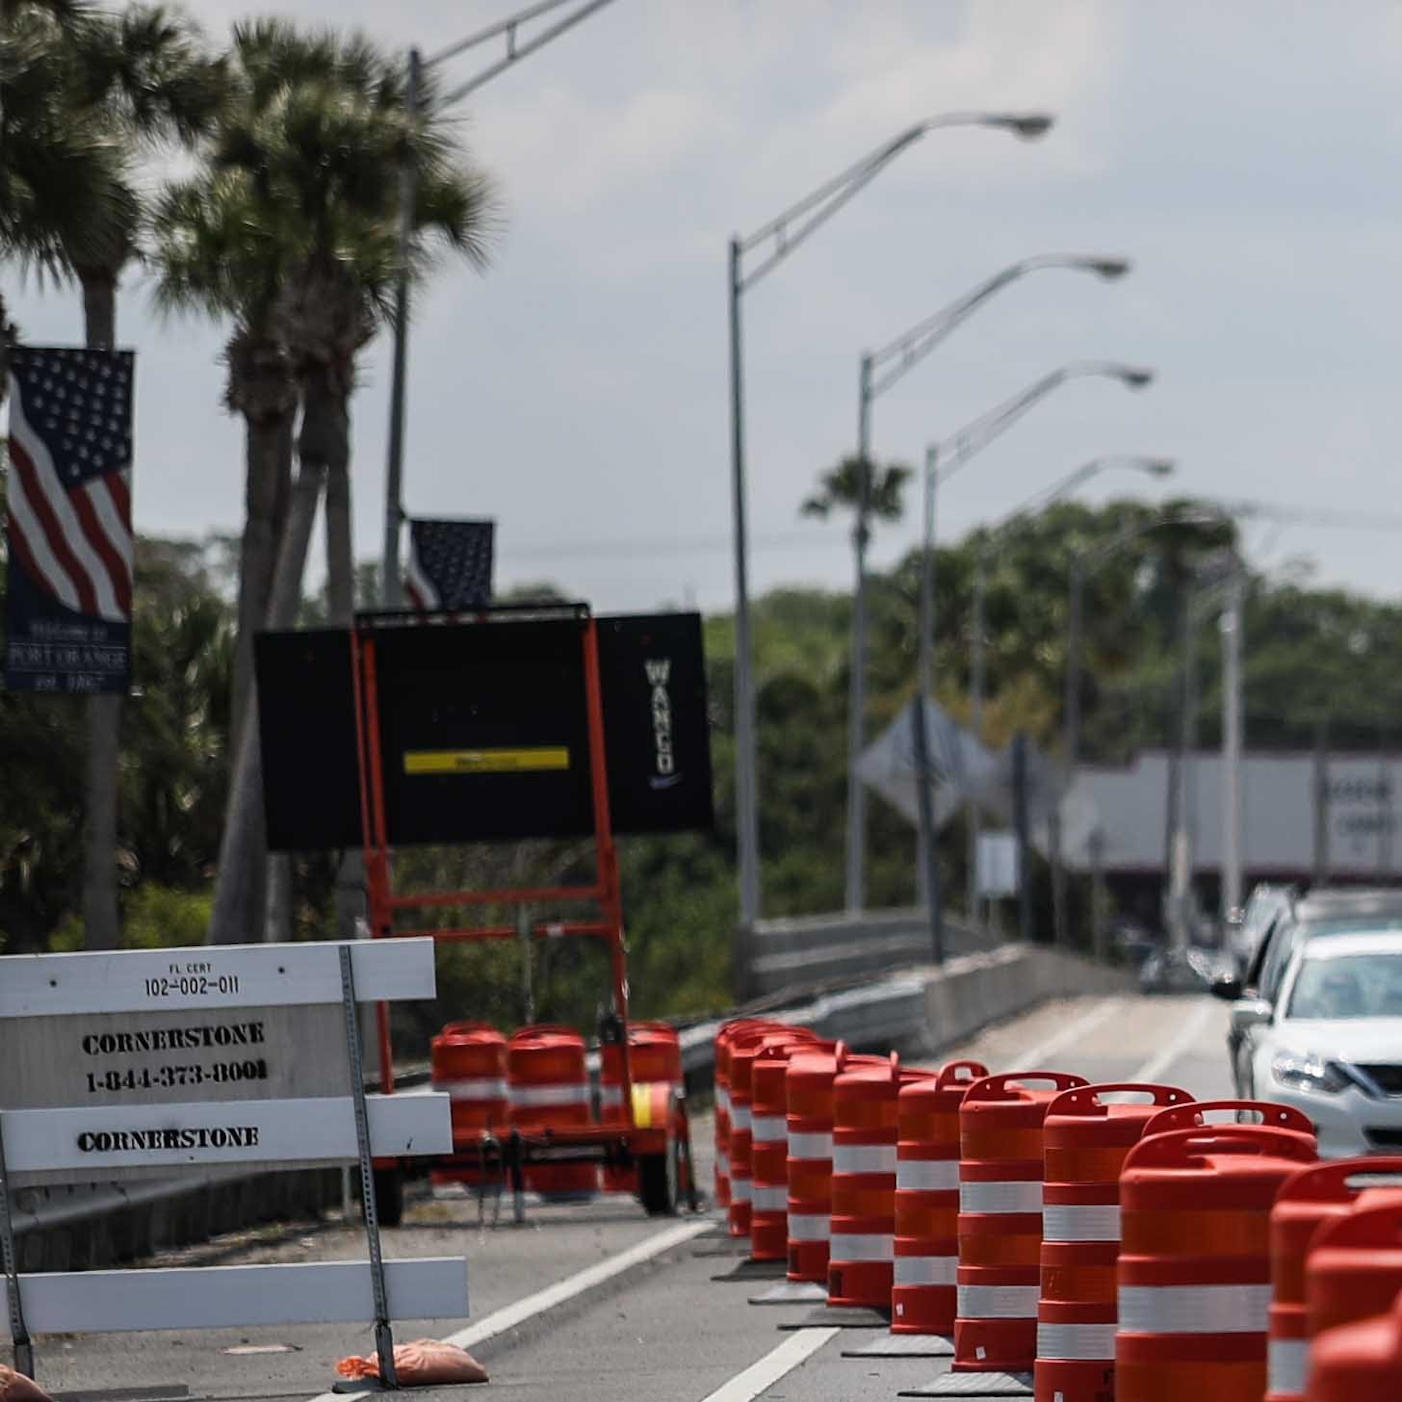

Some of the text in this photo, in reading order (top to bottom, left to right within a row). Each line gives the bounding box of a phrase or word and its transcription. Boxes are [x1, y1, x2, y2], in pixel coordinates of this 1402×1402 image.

[168, 963, 212, 974] FL CERT
[145, 976, 239, 996] 102-002-011
[82, 1022, 265, 1055] CORNERSTONE
[77, 1127, 259, 1152] CORNERSTONE
